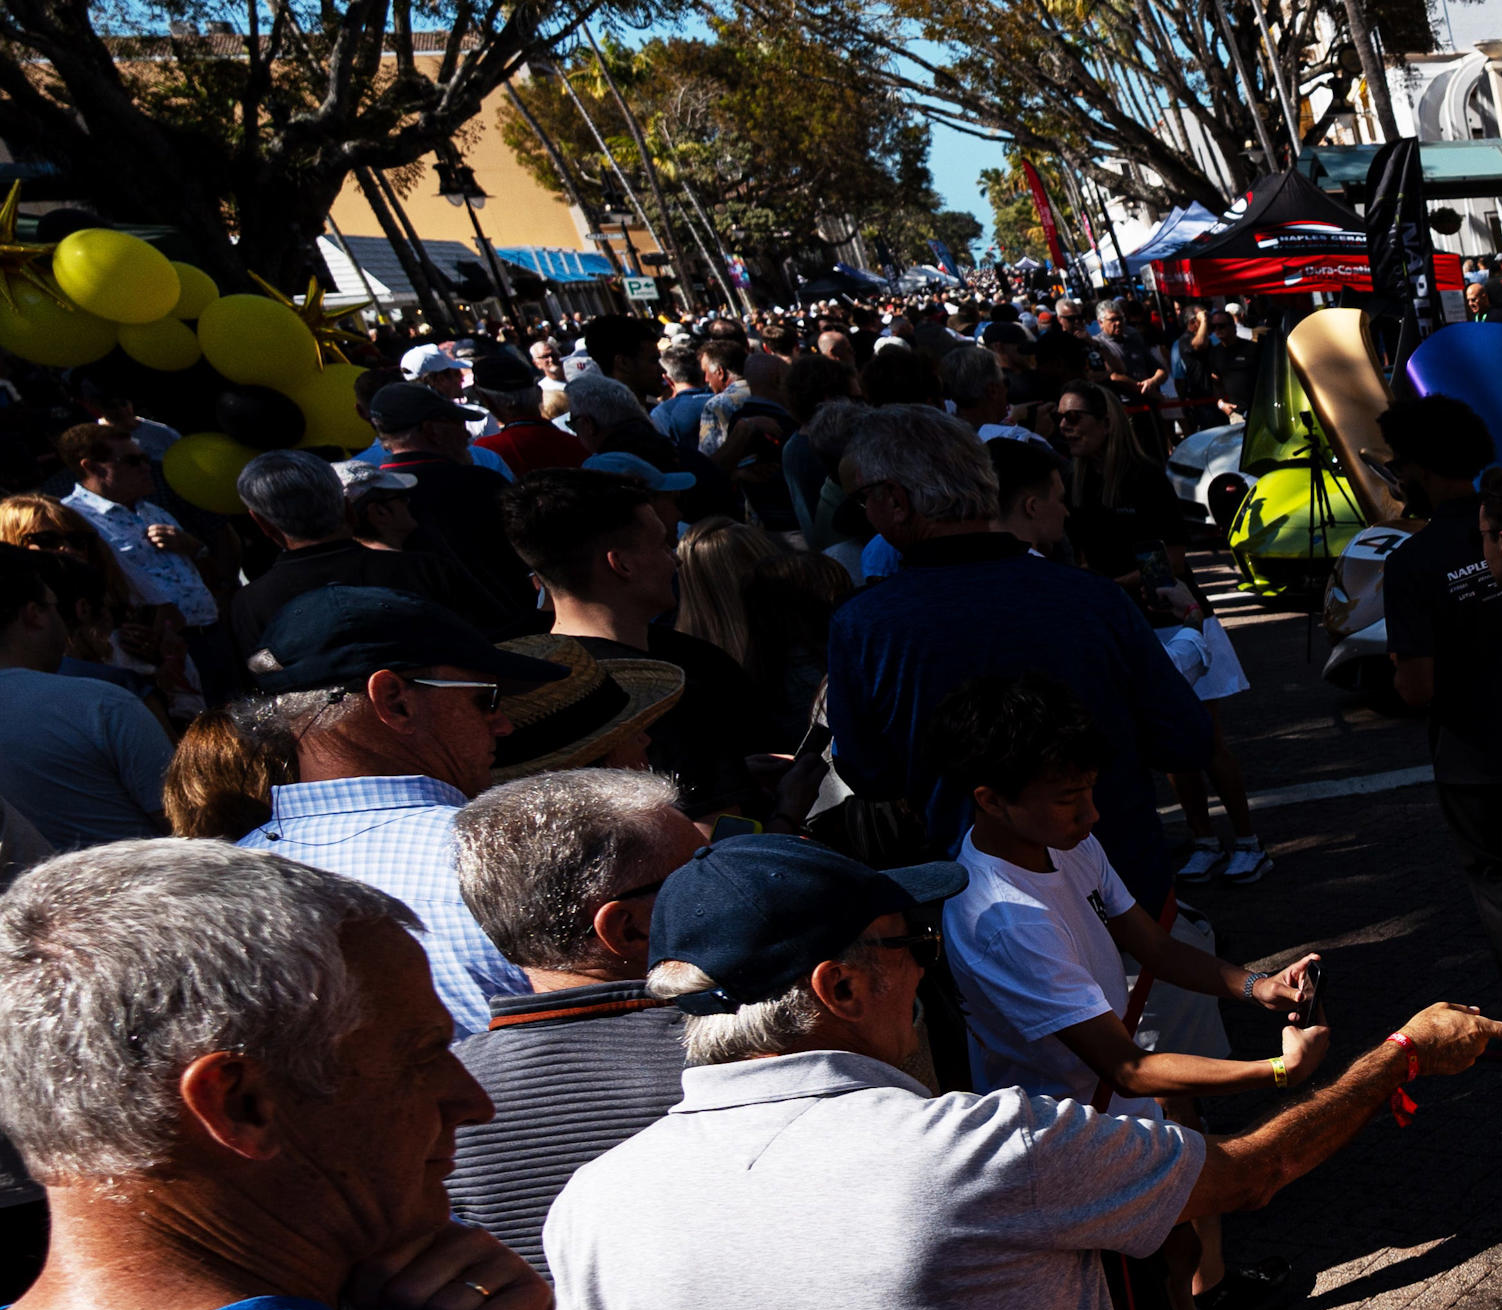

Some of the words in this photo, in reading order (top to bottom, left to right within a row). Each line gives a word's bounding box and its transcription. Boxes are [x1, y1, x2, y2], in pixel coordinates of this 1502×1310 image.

[628, 281, 641, 296] P
[1354, 534, 1404, 555] 4
[1447, 560, 1489, 581] NAPLE
